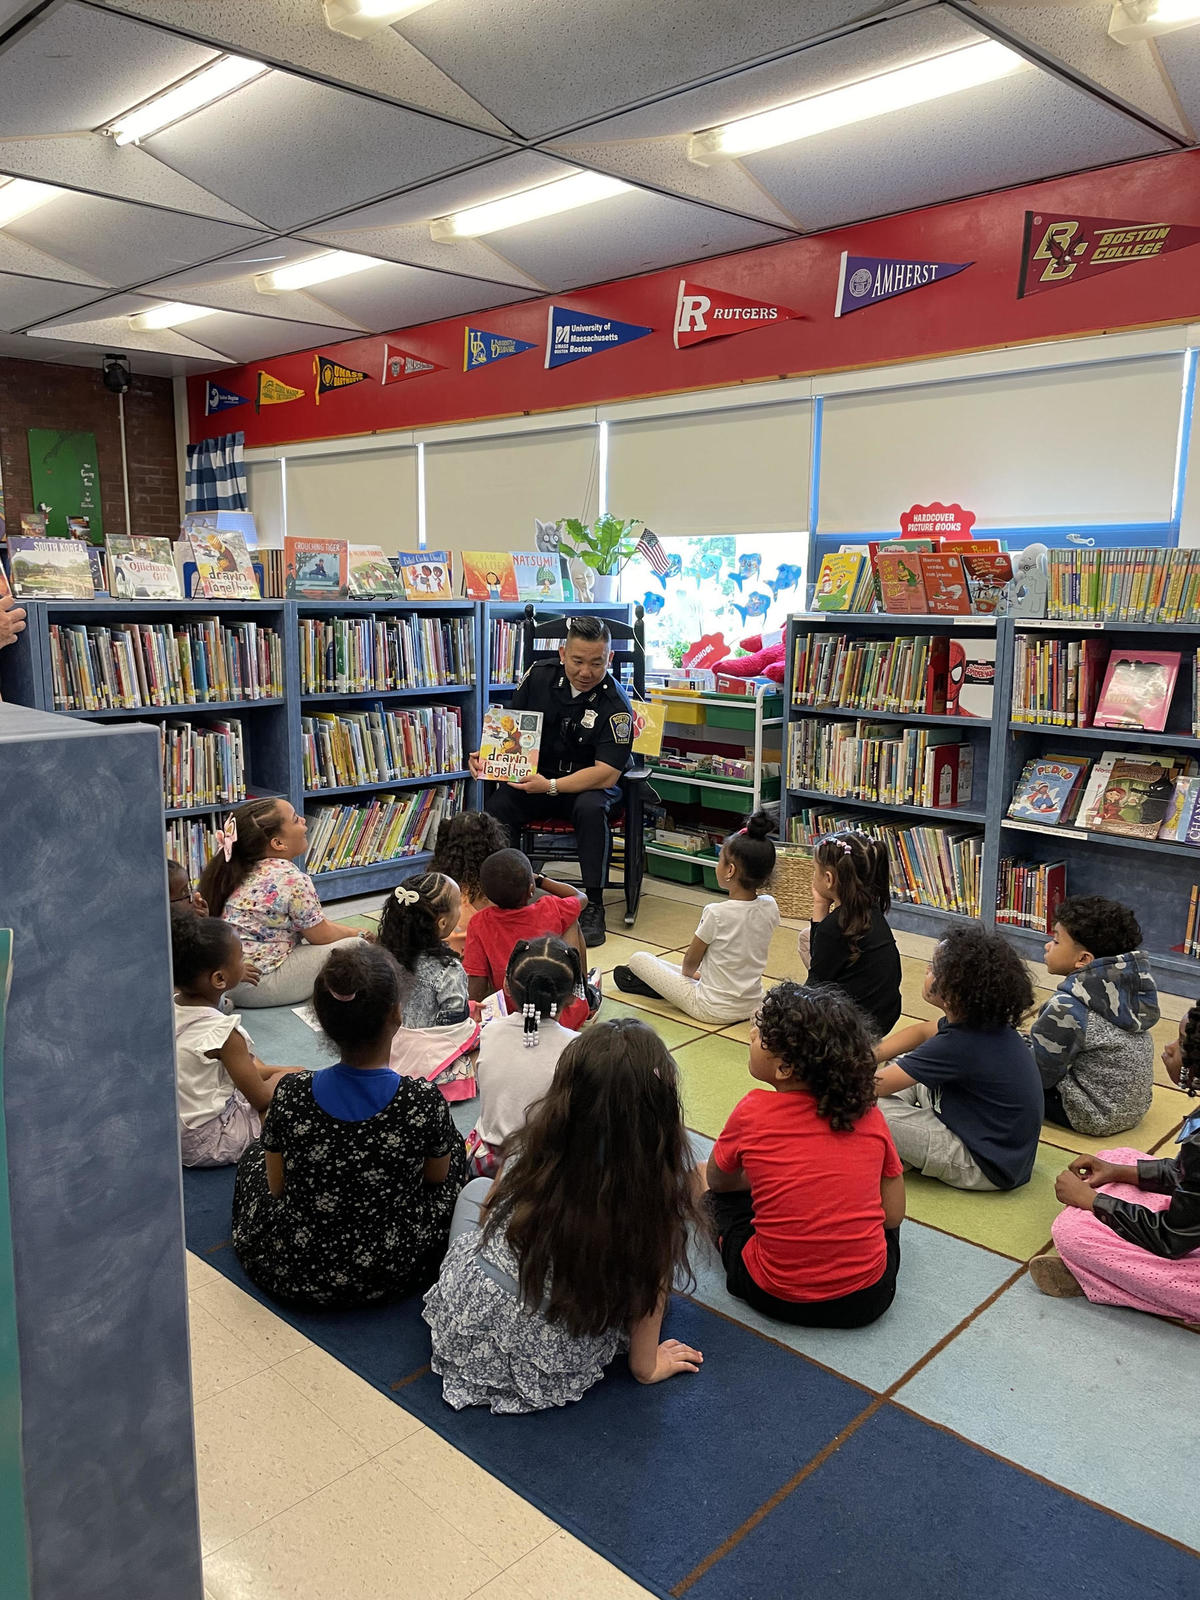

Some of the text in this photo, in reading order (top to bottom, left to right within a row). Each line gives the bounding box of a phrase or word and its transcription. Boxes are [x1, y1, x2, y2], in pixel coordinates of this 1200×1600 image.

[1099, 227, 1171, 246] BOSTON
[1090, 241, 1165, 260] COLLEGE
[871, 263, 939, 298] AMHERST
[678, 295, 711, 332] R
[713, 307, 778, 319] RUTGERS
[571, 322, 611, 332] University of
[571, 333, 619, 342] Massachusetts
[569, 345, 592, 353] Boston
[913, 513, 955, 522] HARDCOVER
[907, 522, 962, 532] PICTURE BOOKS
[33, 541, 84, 552] SOUTH KOREA
[325, 543, 341, 552] TIGER
[208, 565, 247, 582] drawn
[487, 747, 528, 765] drawn
[1036, 764, 1075, 781] PEDRO
